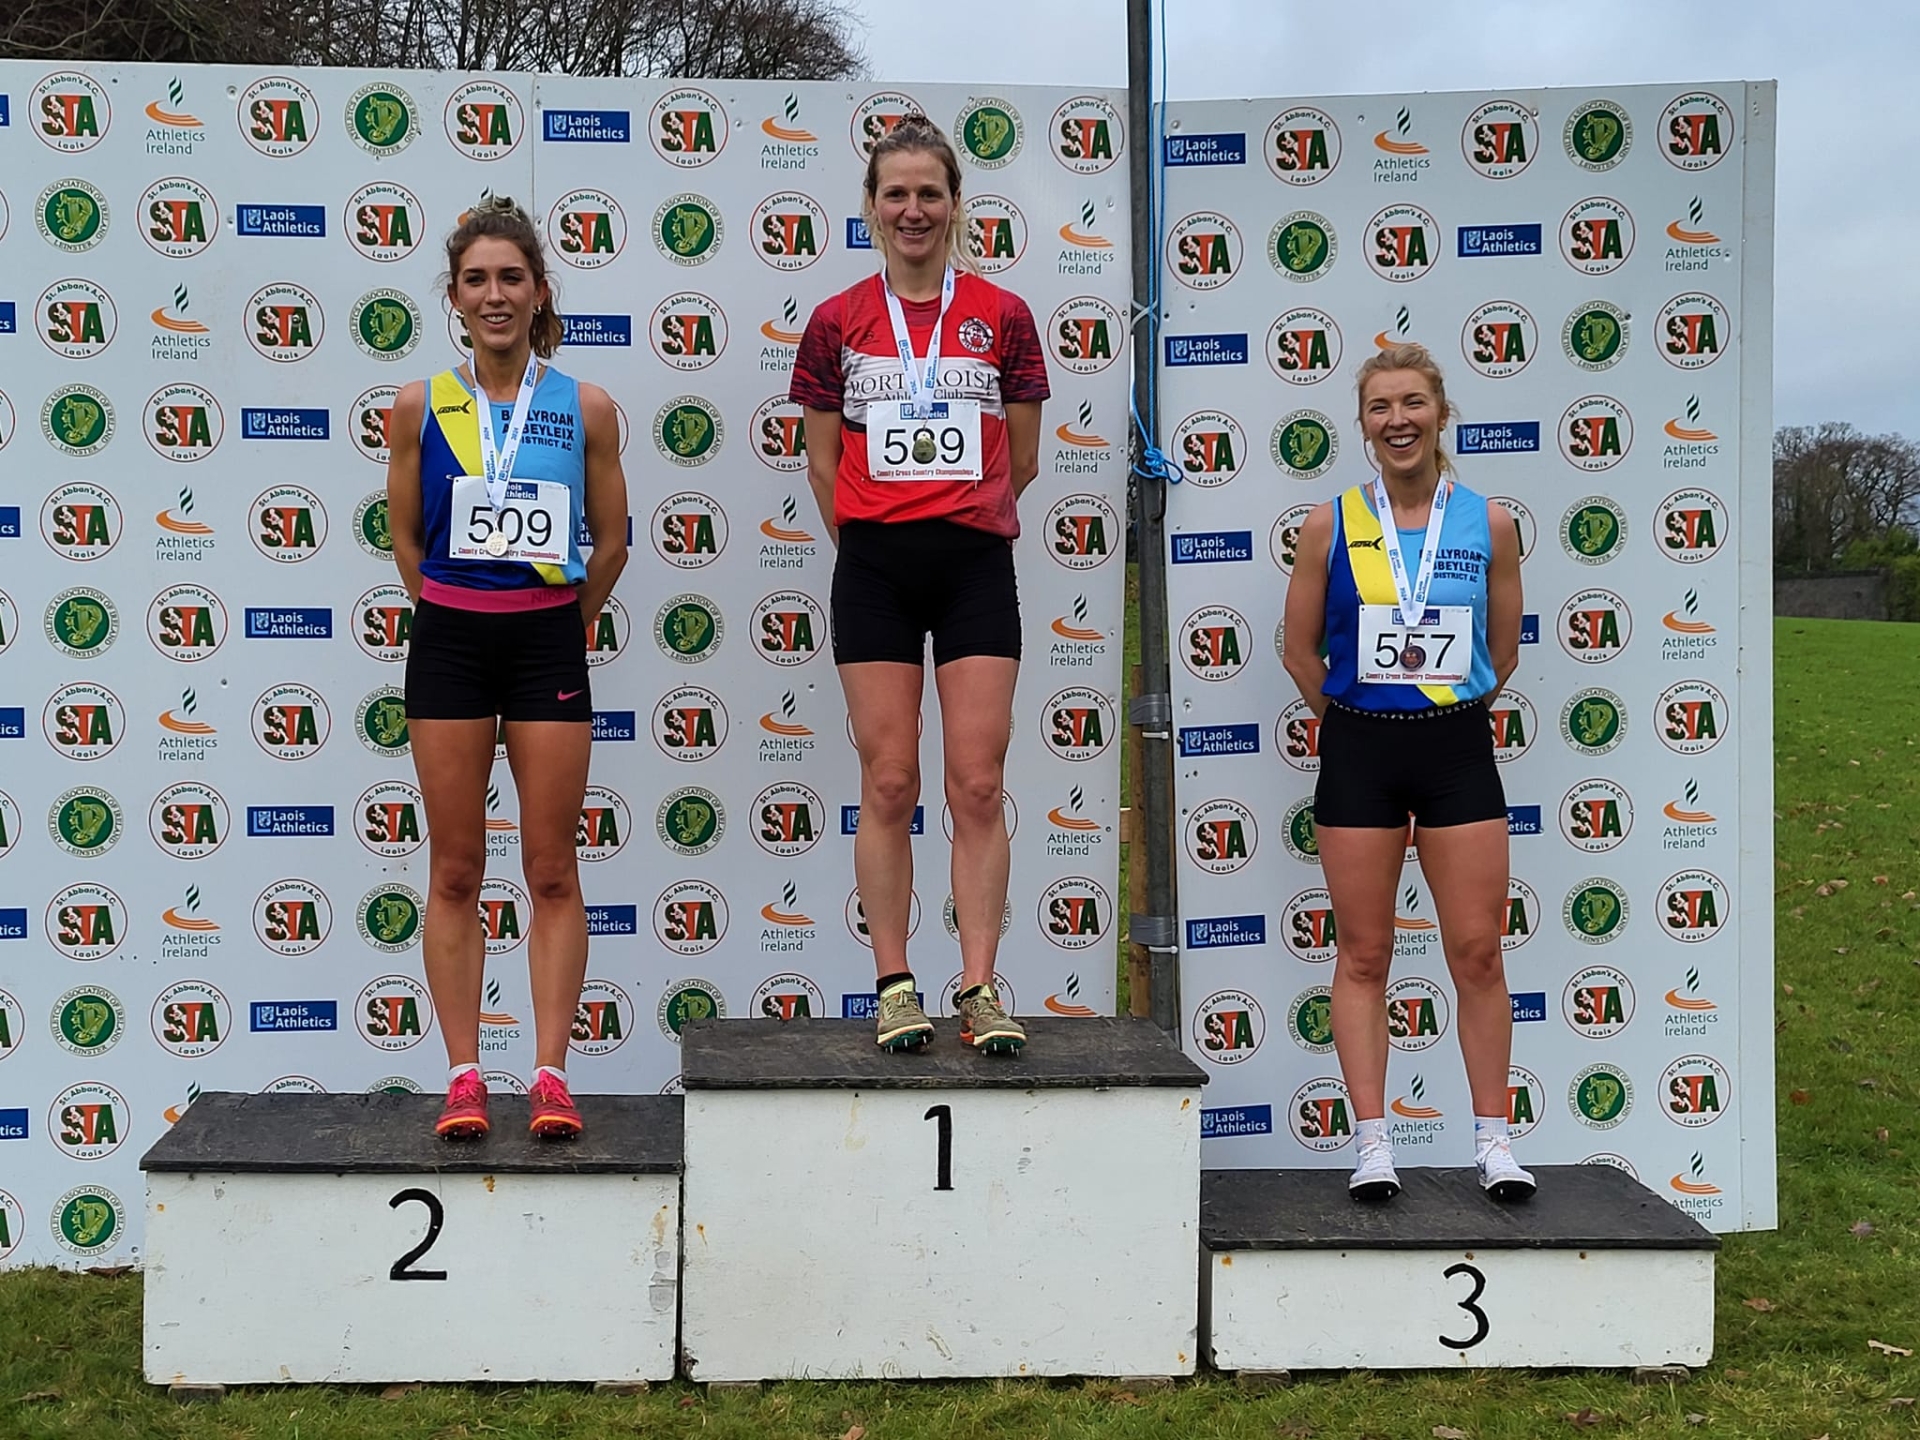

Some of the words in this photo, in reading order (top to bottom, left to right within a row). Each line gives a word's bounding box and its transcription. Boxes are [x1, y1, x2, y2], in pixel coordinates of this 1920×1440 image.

[567, 114, 601, 127] Laois
[145, 129, 205, 142] Athletics
[567, 126, 625, 139] Athletics
[58, 140, 85, 150] Laois
[146, 142, 192, 155] Ireland
[761, 144, 819, 157] Athletics
[1185, 138, 1218, 150] Laois
[1185, 149, 1241, 162] Athletics
[761, 157, 806, 170] Ireland
[1373, 157, 1430, 170] Athletics
[1374, 170, 1418, 183] Ireland
[263, 209, 296, 221] Laois
[263, 221, 320, 234] Athletics
[1481, 228, 1514, 241] Laois
[1481, 240, 1537, 253] Athletics
[1665, 246, 1721, 259] Athletics
[574, 257, 601, 266] Laois
[1058, 249, 1114, 262] Athletics
[1058, 262, 1102, 275] Ireland
[1665, 258, 1708, 272] Ireland
[1389, 271, 1415, 280] Laois
[568, 318, 602, 331] Laois
[151, 334, 211, 347] Athletics
[568, 330, 626, 343] Athletics
[1187, 338, 1220, 350] Laois
[152, 347, 198, 360] Ireland
[1187, 349, 1243, 362] Athletics
[933, 388, 963, 400] Club
[267, 412, 301, 424] Laois
[501, 409, 573, 427] BLYROAN
[267, 424, 324, 437] Athletics
[502, 423, 574, 442] ABEYLEIX
[1480, 426, 1513, 438] Laois
[521, 436, 559, 448] ISTRICT
[1480, 437, 1535, 450] Athletics
[1055, 448, 1111, 461] Athletics
[1663, 444, 1719, 456] Athletics
[1055, 461, 1098, 474] Ireland
[1582, 460, 1608, 469] Laois
[1664, 455, 1706, 468] Ireland
[467, 505, 552, 547] 509
[156, 536, 215, 549] Athletics
[1193, 536, 1225, 548] Laois
[156, 549, 202, 561] Ireland
[759, 544, 816, 556] Athletics
[1193, 546, 1247, 560] Athletics
[760, 556, 803, 568] Ireland
[269, 611, 303, 623] Laois
[269, 623, 327, 635] Athletics
[1050, 642, 1105, 654] Athletics
[1662, 636, 1717, 648] Athletics
[1374, 633, 1456, 669] 557
[1662, 648, 1705, 661] Ireland
[1050, 654, 1093, 666] Ireland
[1201, 729, 1233, 741] Laois
[158, 736, 218, 748] Athletics
[759, 738, 815, 750] Athletics
[1201, 739, 1255, 753] Athletics
[158, 749, 204, 761] Ireland
[759, 750, 802, 762] Ireland
[271, 809, 306, 821] Laois
[271, 821, 329, 833] Athletics
[1663, 825, 1717, 838] Athletics
[1046, 832, 1102, 844] Athletics
[1663, 837, 1705, 849] Ireland
[774, 845, 800, 854] Laois
[1047, 844, 1089, 856] Ireland
[1208, 920, 1239, 933] Laois
[162, 933, 221, 945] Athletics
[760, 927, 816, 940] Athletics
[1208, 931, 1261, 944] Athletics
[162, 945, 208, 958] Ireland
[280, 944, 307, 953] Laois
[761, 939, 803, 952] Ireland
[274, 1004, 309, 1017] Laois
[274, 1016, 332, 1028] Athletics
[1664, 1012, 1718, 1025] Athletics
[1665, 1024, 1706, 1036] Ireland
[1214, 1110, 1245, 1123] Laois
[1214, 1120, 1267, 1134] Athletics
[1391, 1120, 1445, 1134] Athletics
[1392, 1132, 1433, 1146] Ireland
[923, 1105, 954, 1191] 1
[388, 1188, 448, 1280] 2
[1439, 1262, 1491, 1350] 3
